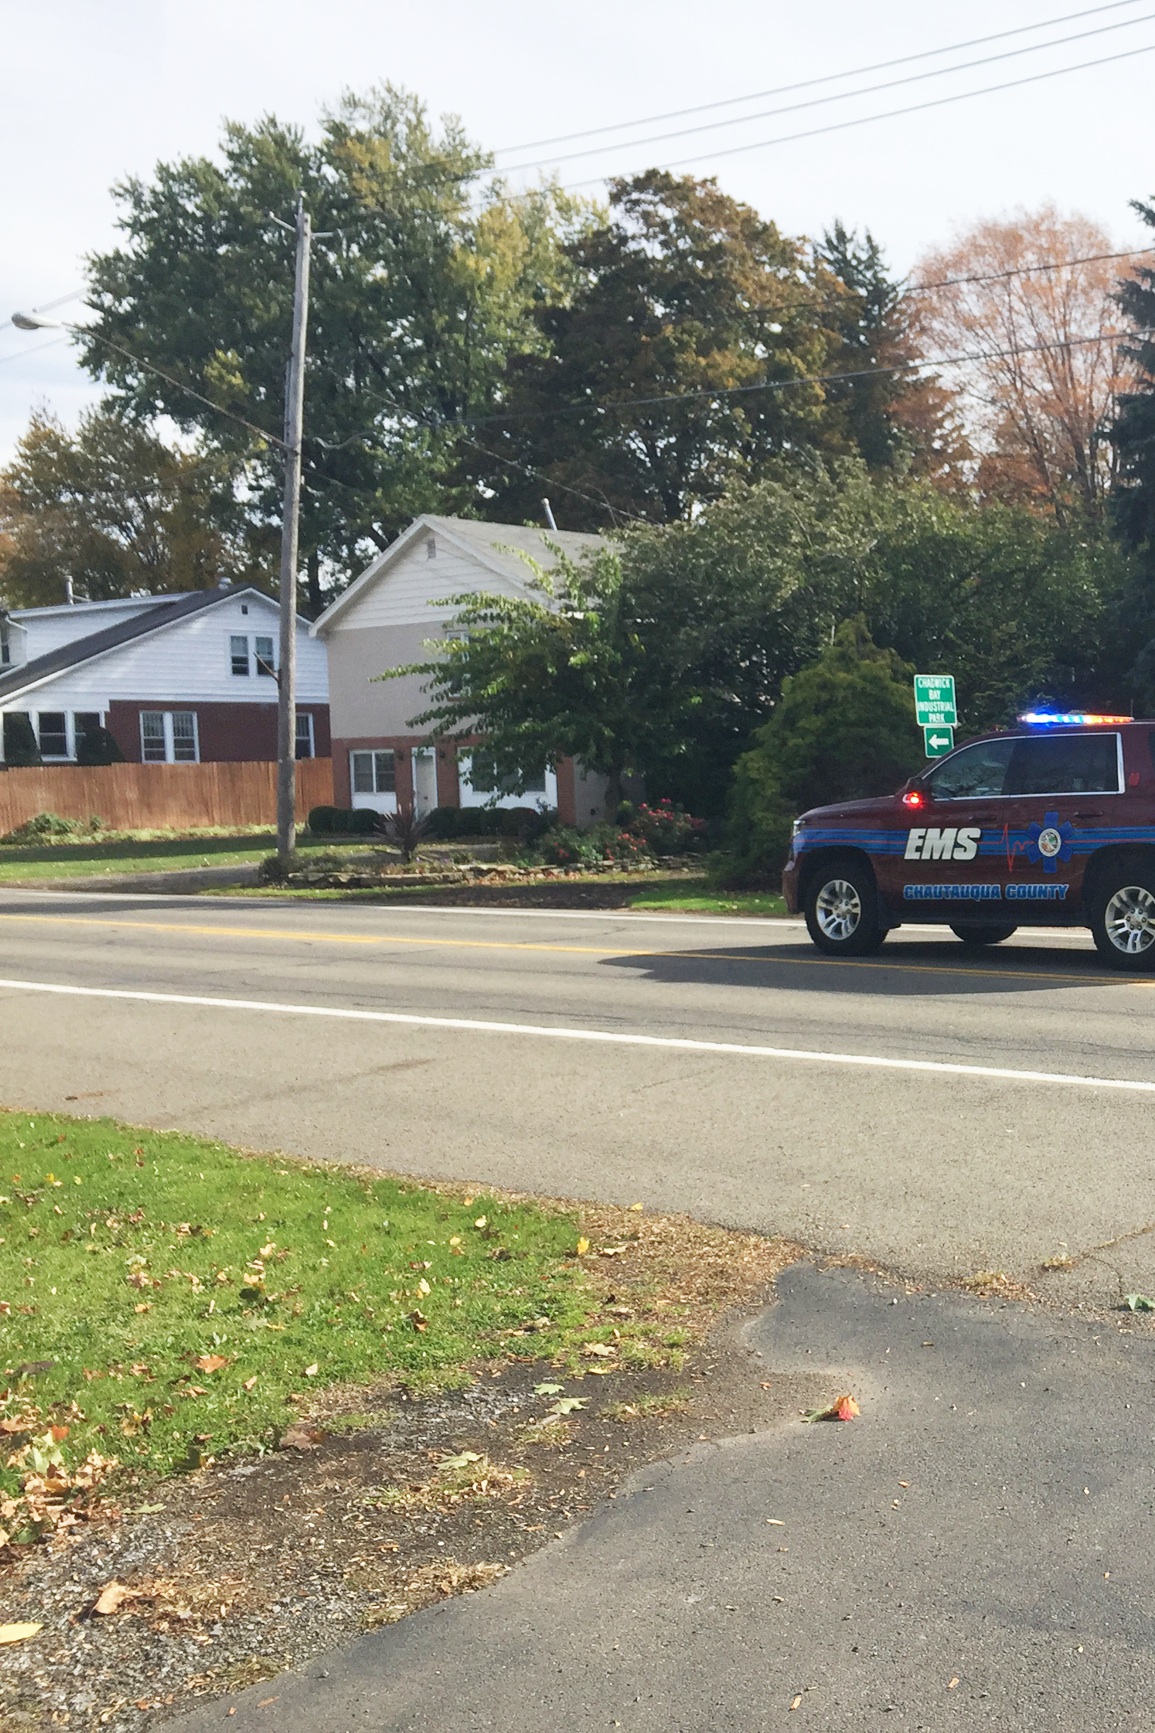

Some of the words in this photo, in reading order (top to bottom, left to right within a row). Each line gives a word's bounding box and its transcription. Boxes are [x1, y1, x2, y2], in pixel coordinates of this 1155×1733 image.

[918, 677, 951, 689] CHADWICK
[929, 689, 941, 700] BAY
[917, 701, 954, 712] INDUSTRIAL
[929, 713, 945, 724] PARK
[904, 827, 982, 861] EMS
[903, 884, 1002, 902] CHAUTAUQUA
[1005, 884, 1069, 900] COUNTY
